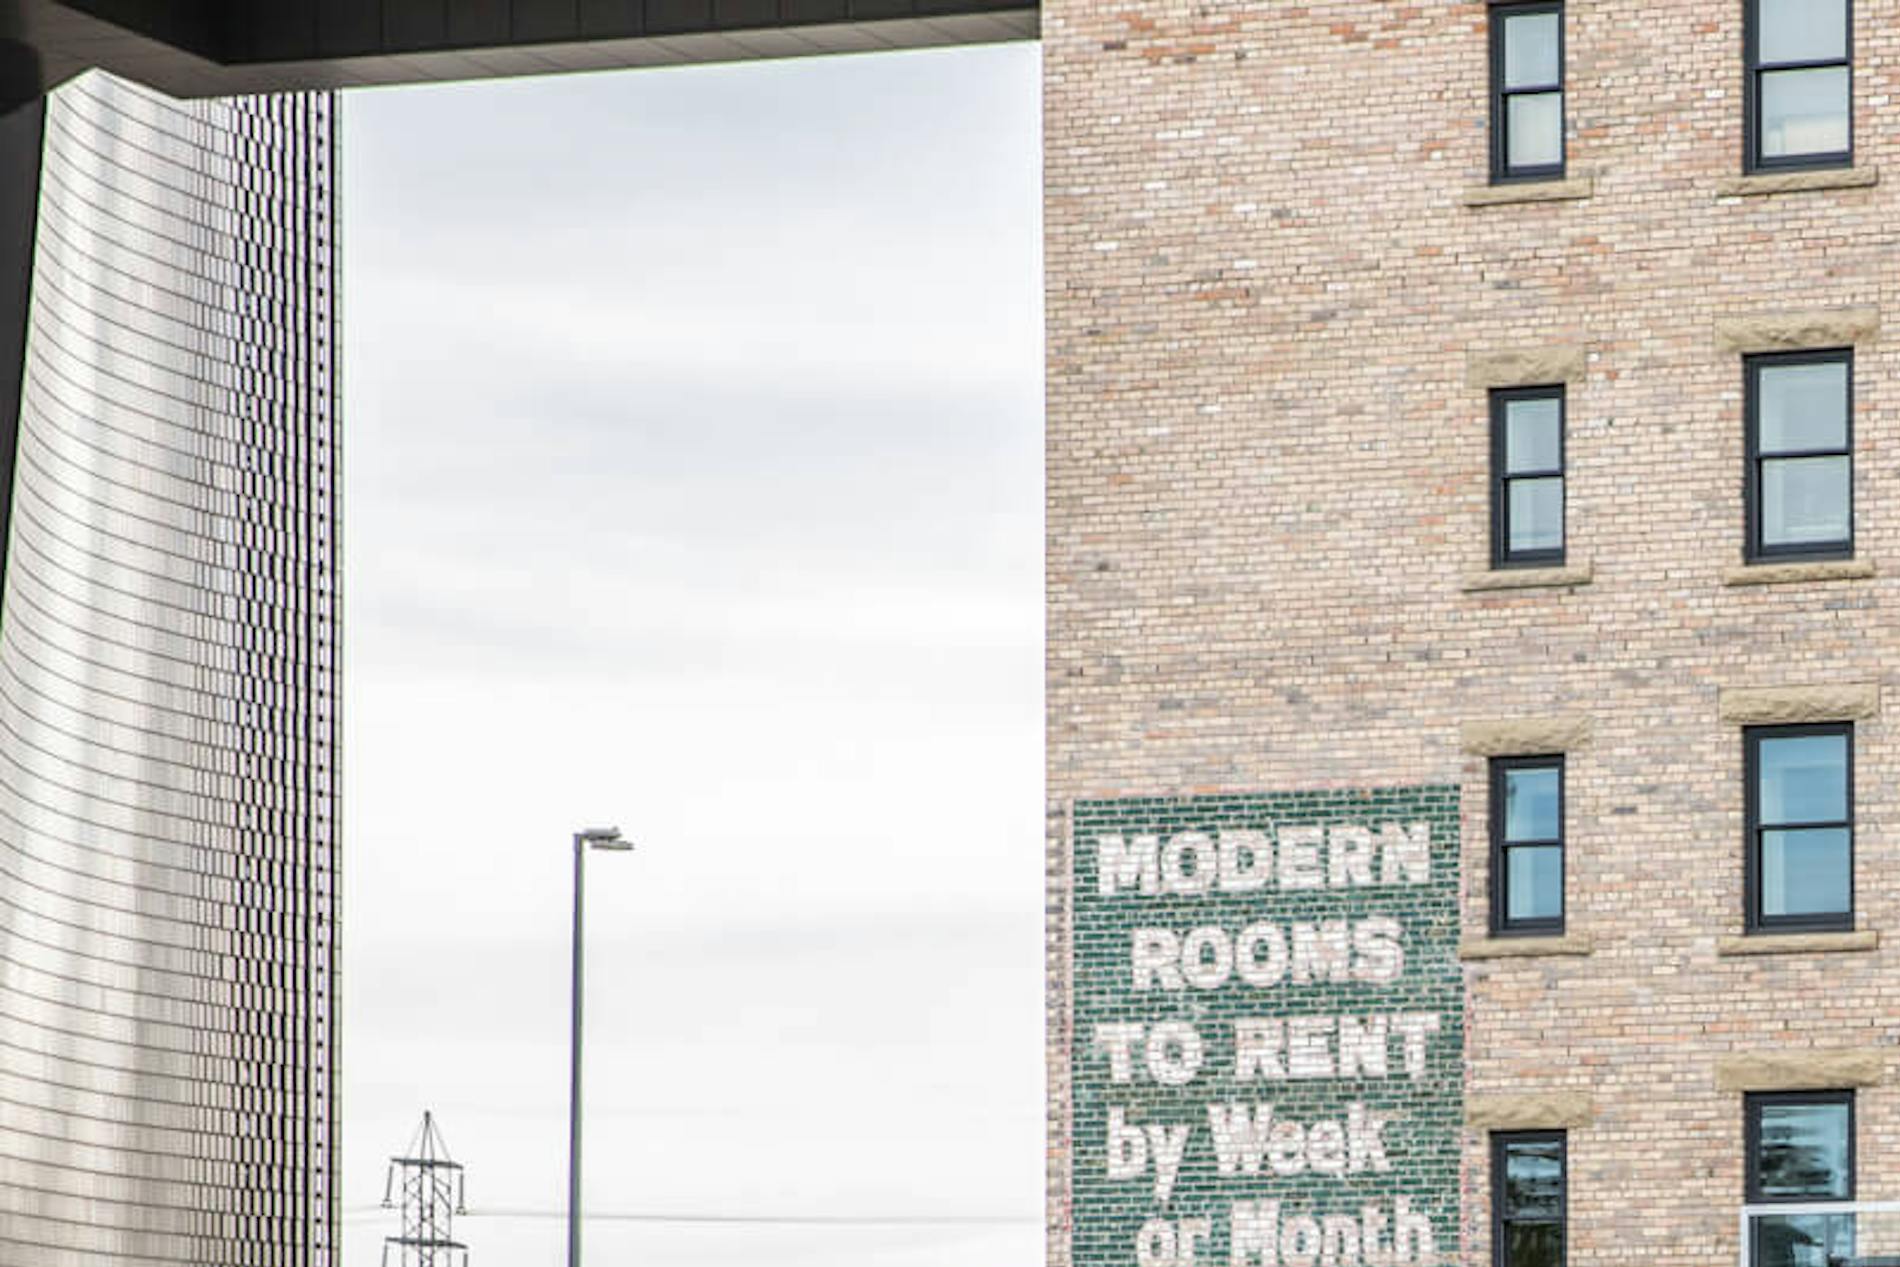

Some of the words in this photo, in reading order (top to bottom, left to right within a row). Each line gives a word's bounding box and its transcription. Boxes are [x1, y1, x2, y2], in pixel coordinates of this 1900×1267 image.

[1098, 821, 1431, 897] MODERN
[1130, 917, 1404, 990] ROOMS
[1096, 1021, 1200, 1084] TO
[1234, 1013, 1440, 1081] RENT
[1106, 1106, 1189, 1200] by
[1207, 1102, 1391, 1177] Week
